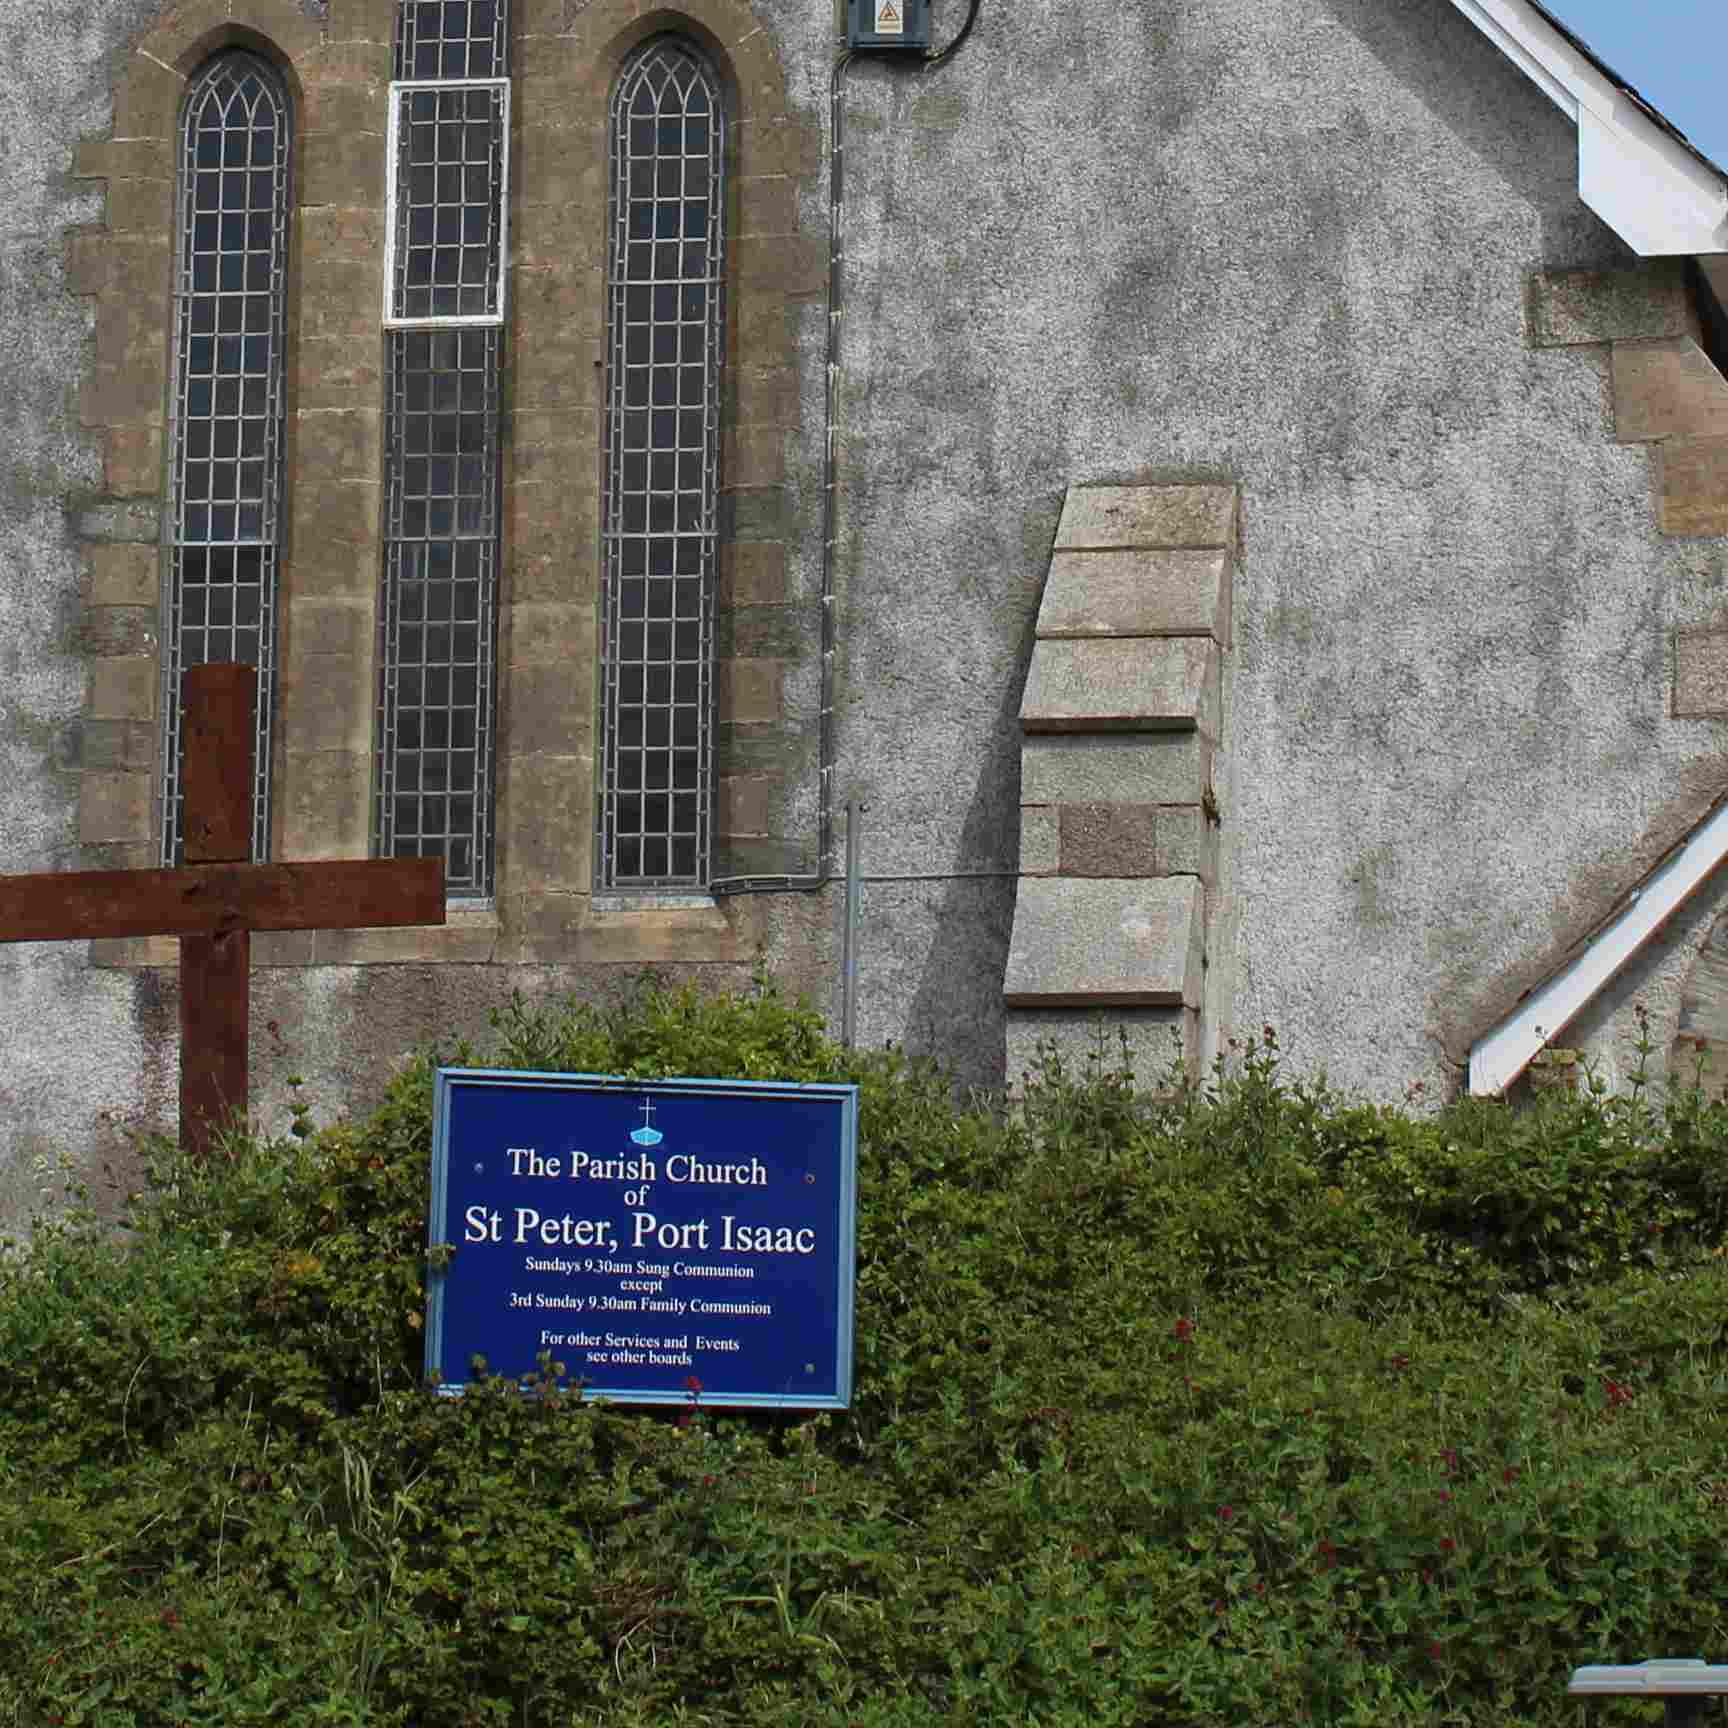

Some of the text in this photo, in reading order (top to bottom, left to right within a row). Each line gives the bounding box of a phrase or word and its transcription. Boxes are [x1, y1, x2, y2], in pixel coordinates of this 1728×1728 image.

[506, 1148, 768, 1185] The Parish Church
[624, 1184, 650, 1206] of
[465, 1205, 815, 1254] St Peter, Port Isaac
[525, 1256, 754, 1278] Sundays 9.30am Sung Communion
[620, 1278, 663, 1294] except
[510, 1292, 772, 1315] 3rd Sunday 9.30am Family Communion
[541, 1330, 739, 1351] For other Services and Events
[585, 1350, 693, 1367] see other boards
